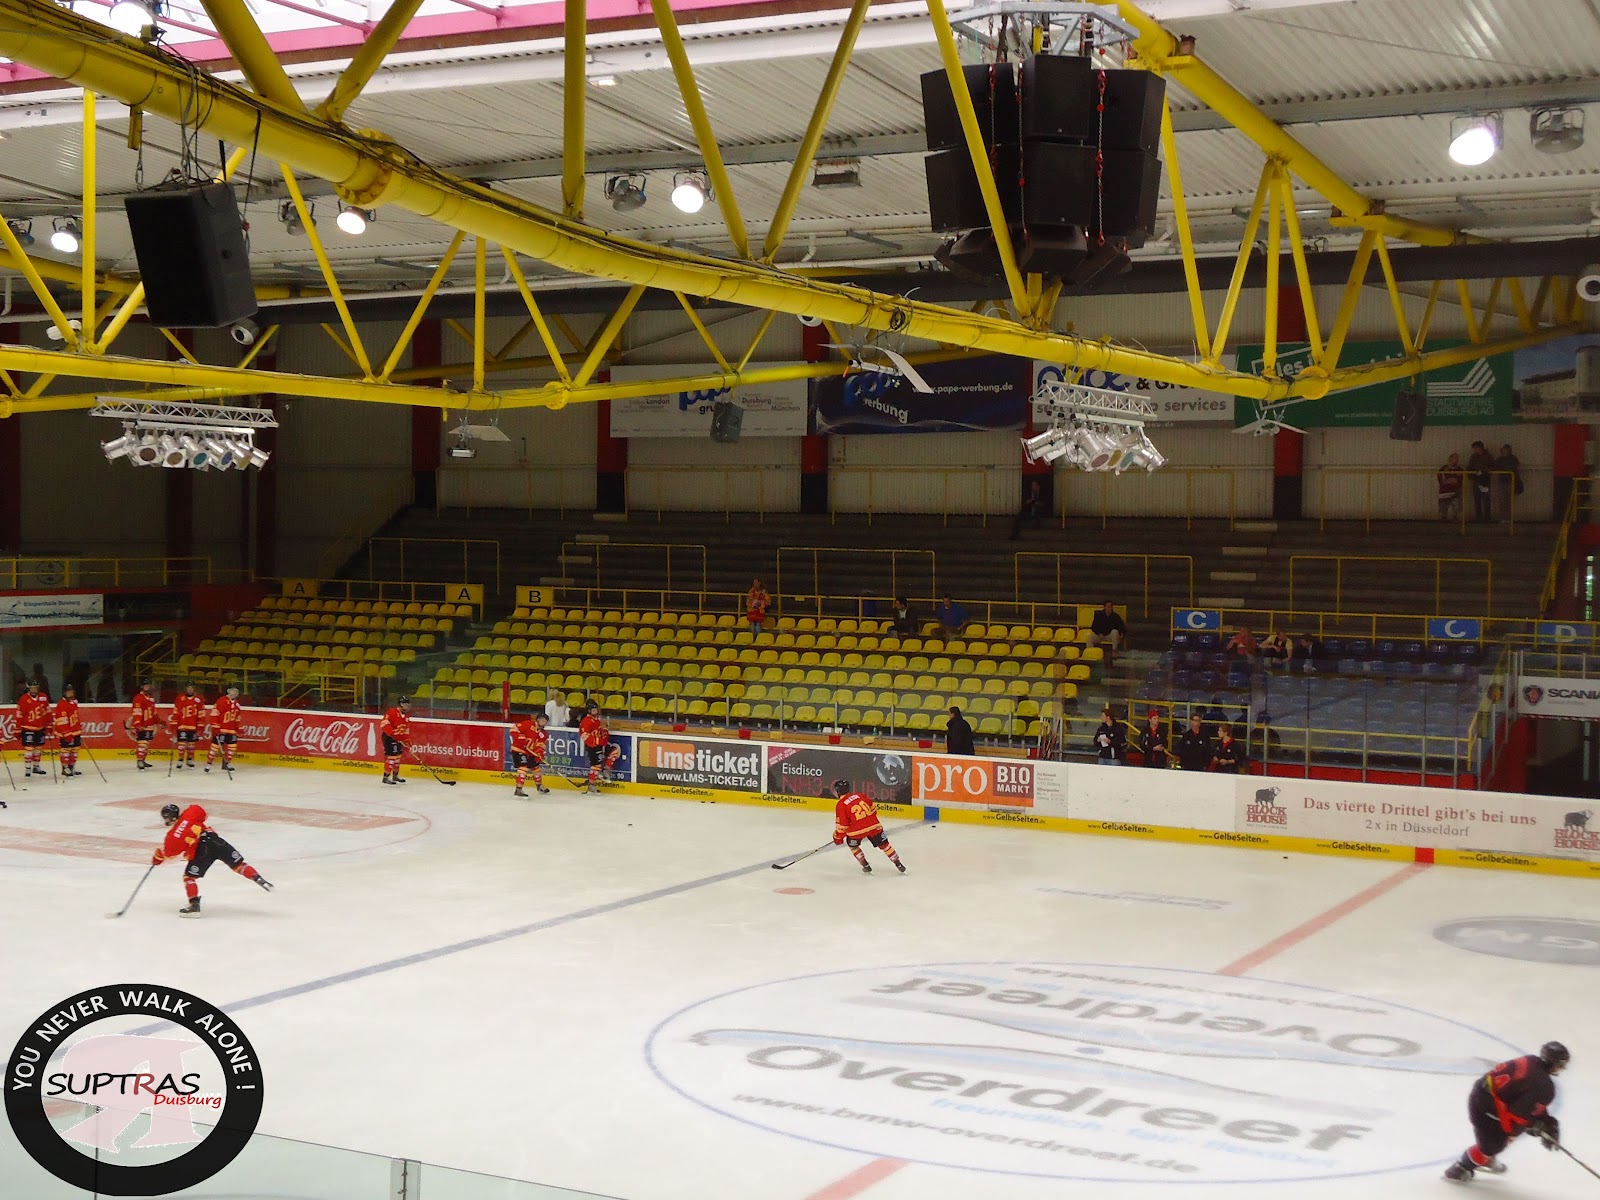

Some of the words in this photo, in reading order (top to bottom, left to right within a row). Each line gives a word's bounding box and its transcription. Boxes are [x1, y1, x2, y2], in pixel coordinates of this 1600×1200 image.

[912, 383, 1014, 394] w.pape-werbung.de
[1164, 399, 1227, 412] services
[294, 582, 306, 595] A
[458, 587, 471, 601] A
[528, 590, 542, 603] B
[1186, 611, 1208, 629] C
[1444, 619, 1467, 638] C
[1555, 624, 1577, 642] D
[409, 743, 454, 757] parkasse
[455, 745, 500, 762] Duisburg
[782, 762, 823, 777] Eisdisco
[996, 765, 1031, 785] BIO
[656, 772, 759, 788] www.LMS-TICKET.de
[916, 762, 988, 801] pro
[996, 784, 1031, 795] MARKT
[1246, 804, 1288, 816] BLOCK
[1303, 798, 1331, 811] Das
[1336, 800, 1376, 814] vierte
[1381, 803, 1430, 818] Drittel
[1435, 807, 1476, 822] gibt's
[1482, 810, 1504, 823] bei
[1510, 815, 1537, 826] uns
[1246, 814, 1288, 826] HOUSE
[1386, 821, 1397, 832] in
[1403, 822, 1471, 837] Düsseldorf
[745, 1043, 1373, 1153] Overdreef
[731, 1092, 1201, 1174] www.bmw-overdreef.de
